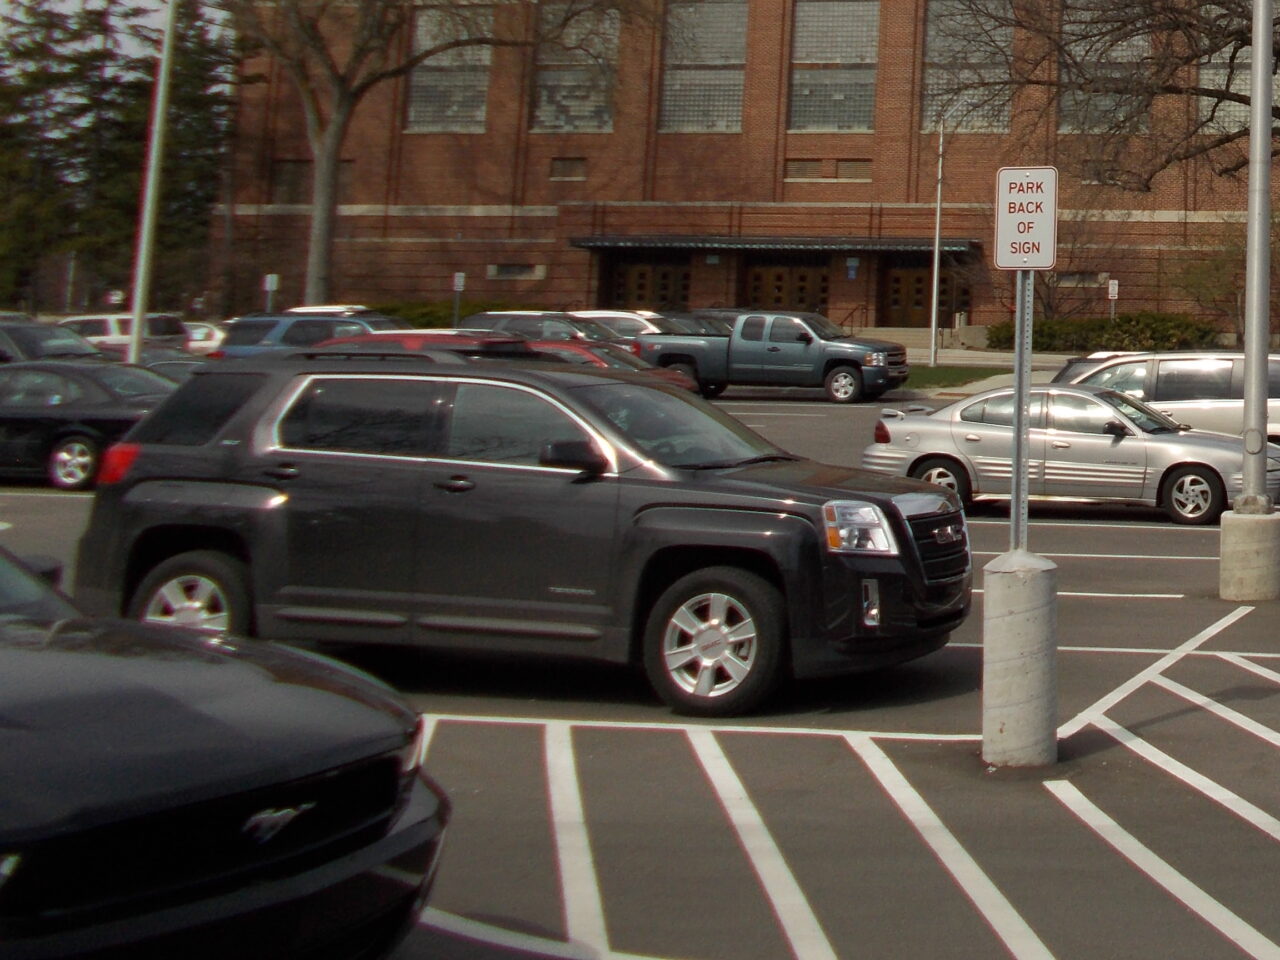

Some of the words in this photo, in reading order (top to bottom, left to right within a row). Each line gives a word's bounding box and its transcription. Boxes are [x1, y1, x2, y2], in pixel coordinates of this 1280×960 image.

[1008, 182, 1044, 194] PARK
[1008, 202, 1044, 214] BACK
[1017, 221, 1035, 234] OF
[1010, 242, 1040, 254] SIGN
